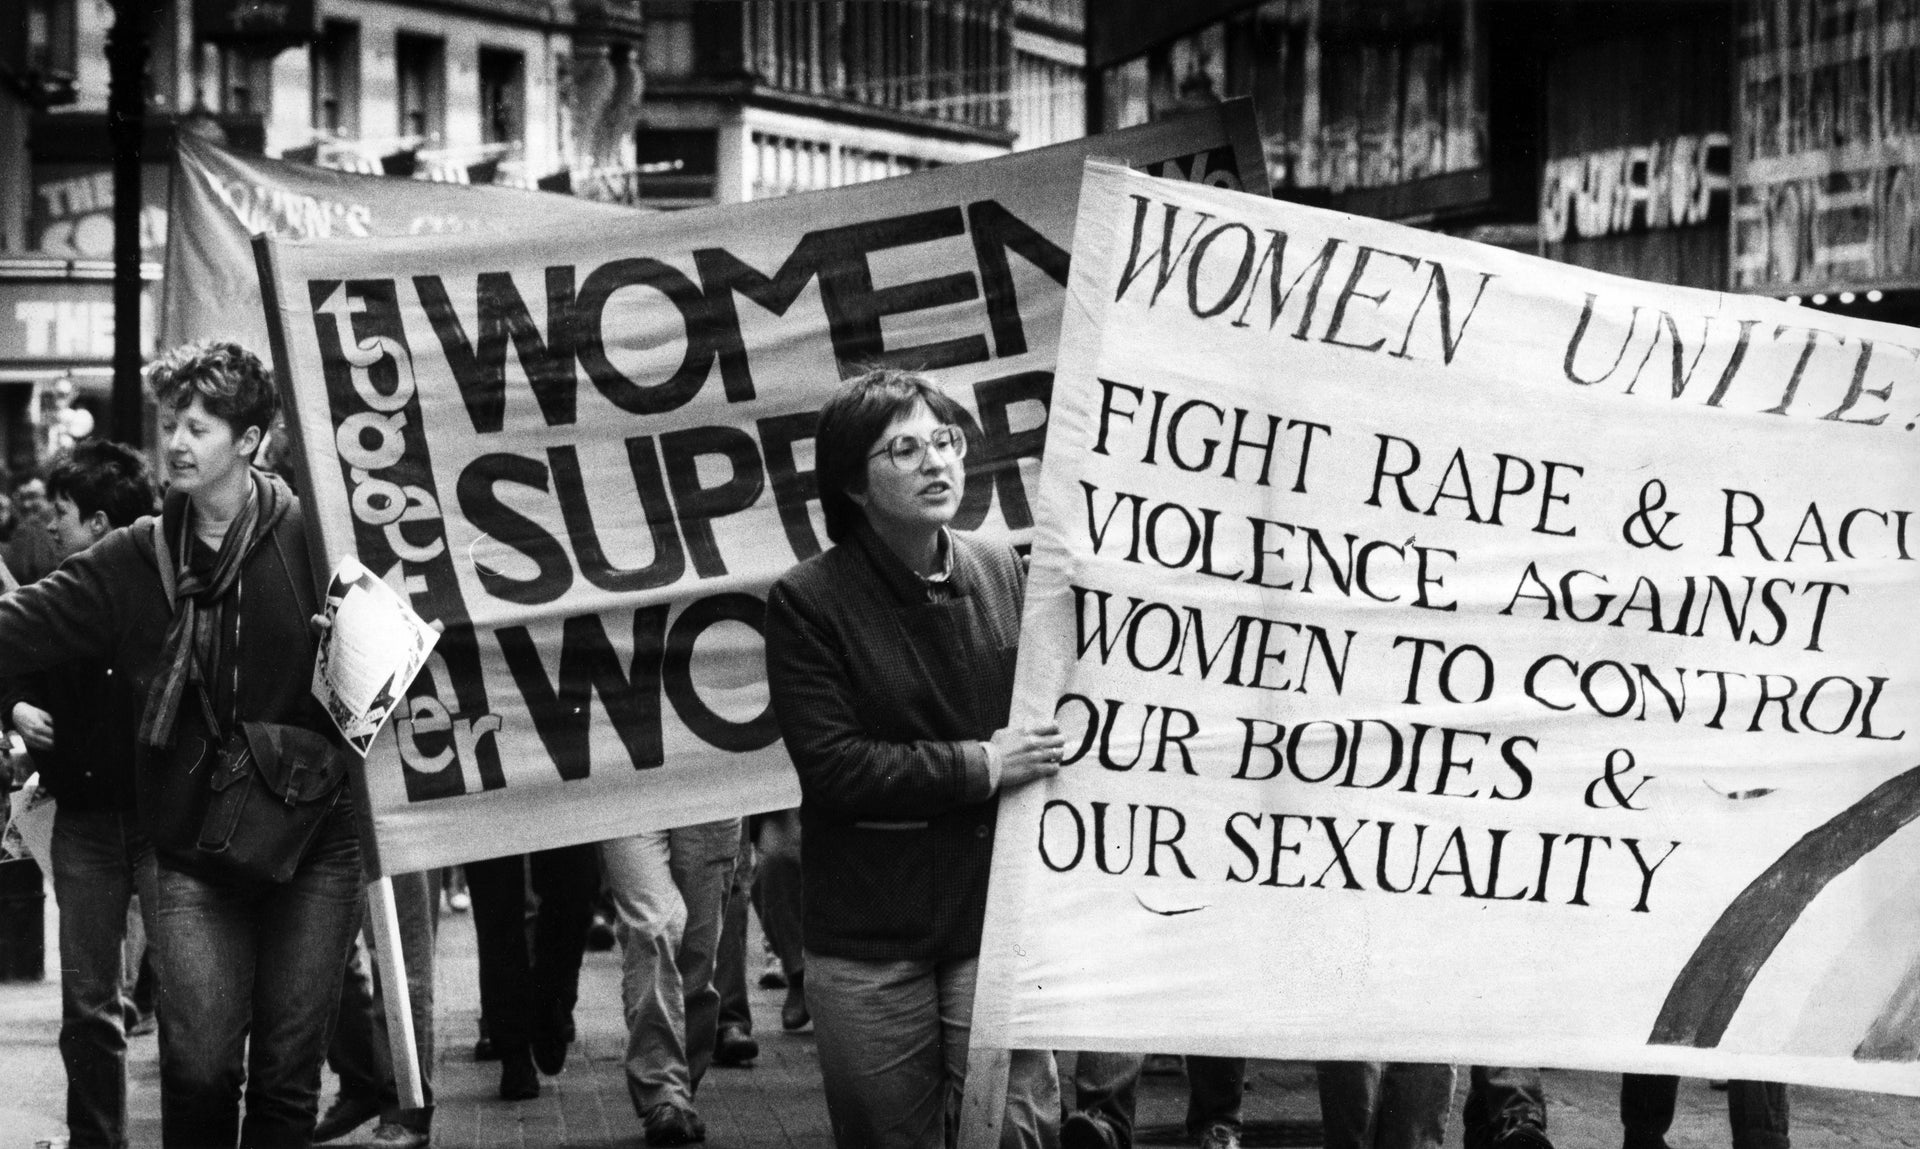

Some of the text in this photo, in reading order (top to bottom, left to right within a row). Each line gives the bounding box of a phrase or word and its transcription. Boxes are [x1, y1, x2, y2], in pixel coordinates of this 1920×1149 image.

[412, 199, 1070, 434] WOMEN
[1117, 195, 1501, 366] WOMEN
[1091, 378, 1918, 562] FIGHT RAPE & RACI
[1079, 480, 1850, 652] VIOLENCE AGAINST
[1069, 585, 1906, 740] WOMEN TO CONTROL
[1054, 693, 1658, 811] OUR BODIES &
[1038, 799, 1682, 912] OUR SEXUALITY
